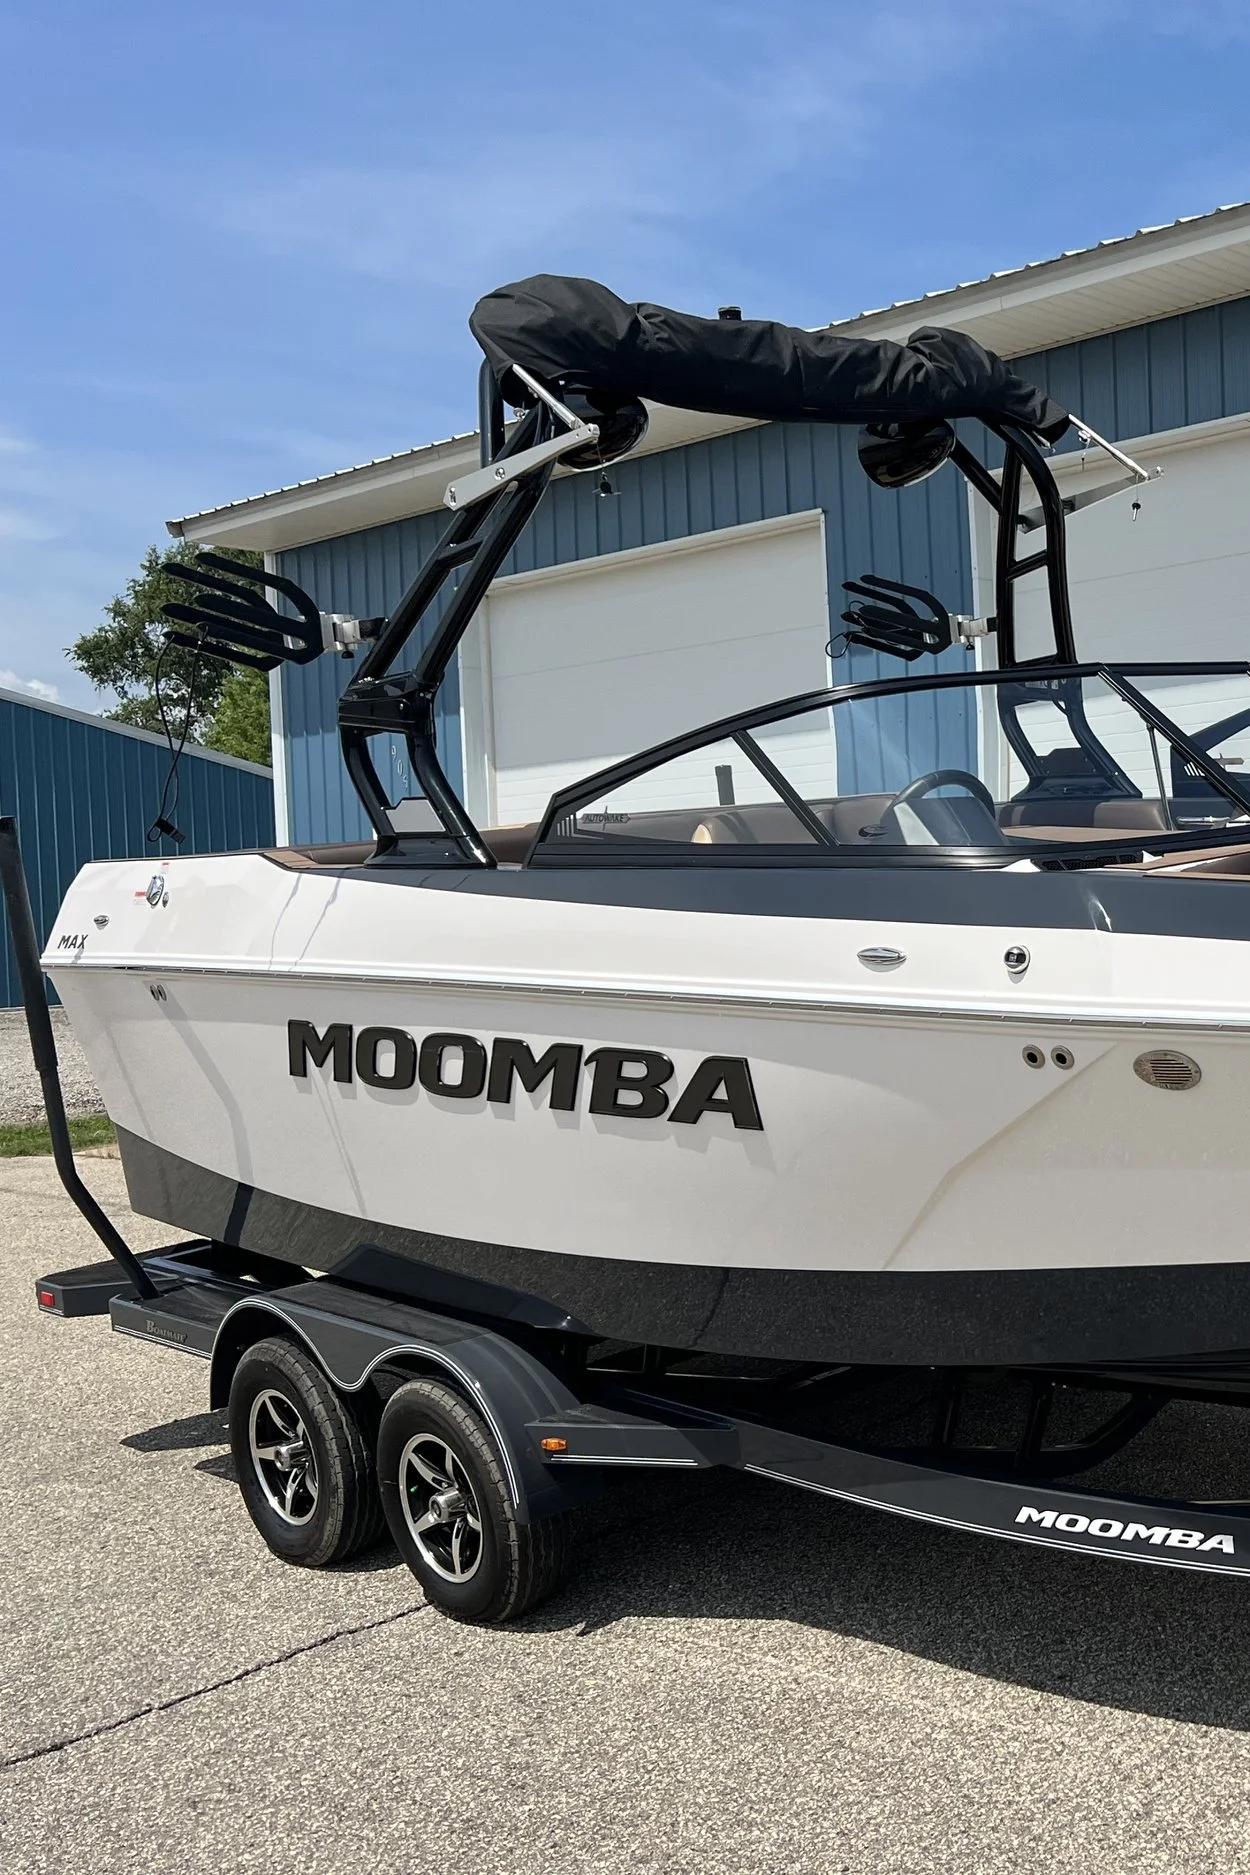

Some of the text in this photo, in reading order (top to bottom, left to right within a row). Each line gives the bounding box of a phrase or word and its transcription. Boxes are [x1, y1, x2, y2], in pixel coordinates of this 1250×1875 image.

[57, 934, 89, 949] MAX
[287, 1018, 765, 1132] MOOMBA
[1014, 1505, 1236, 1555] MOOMBA
